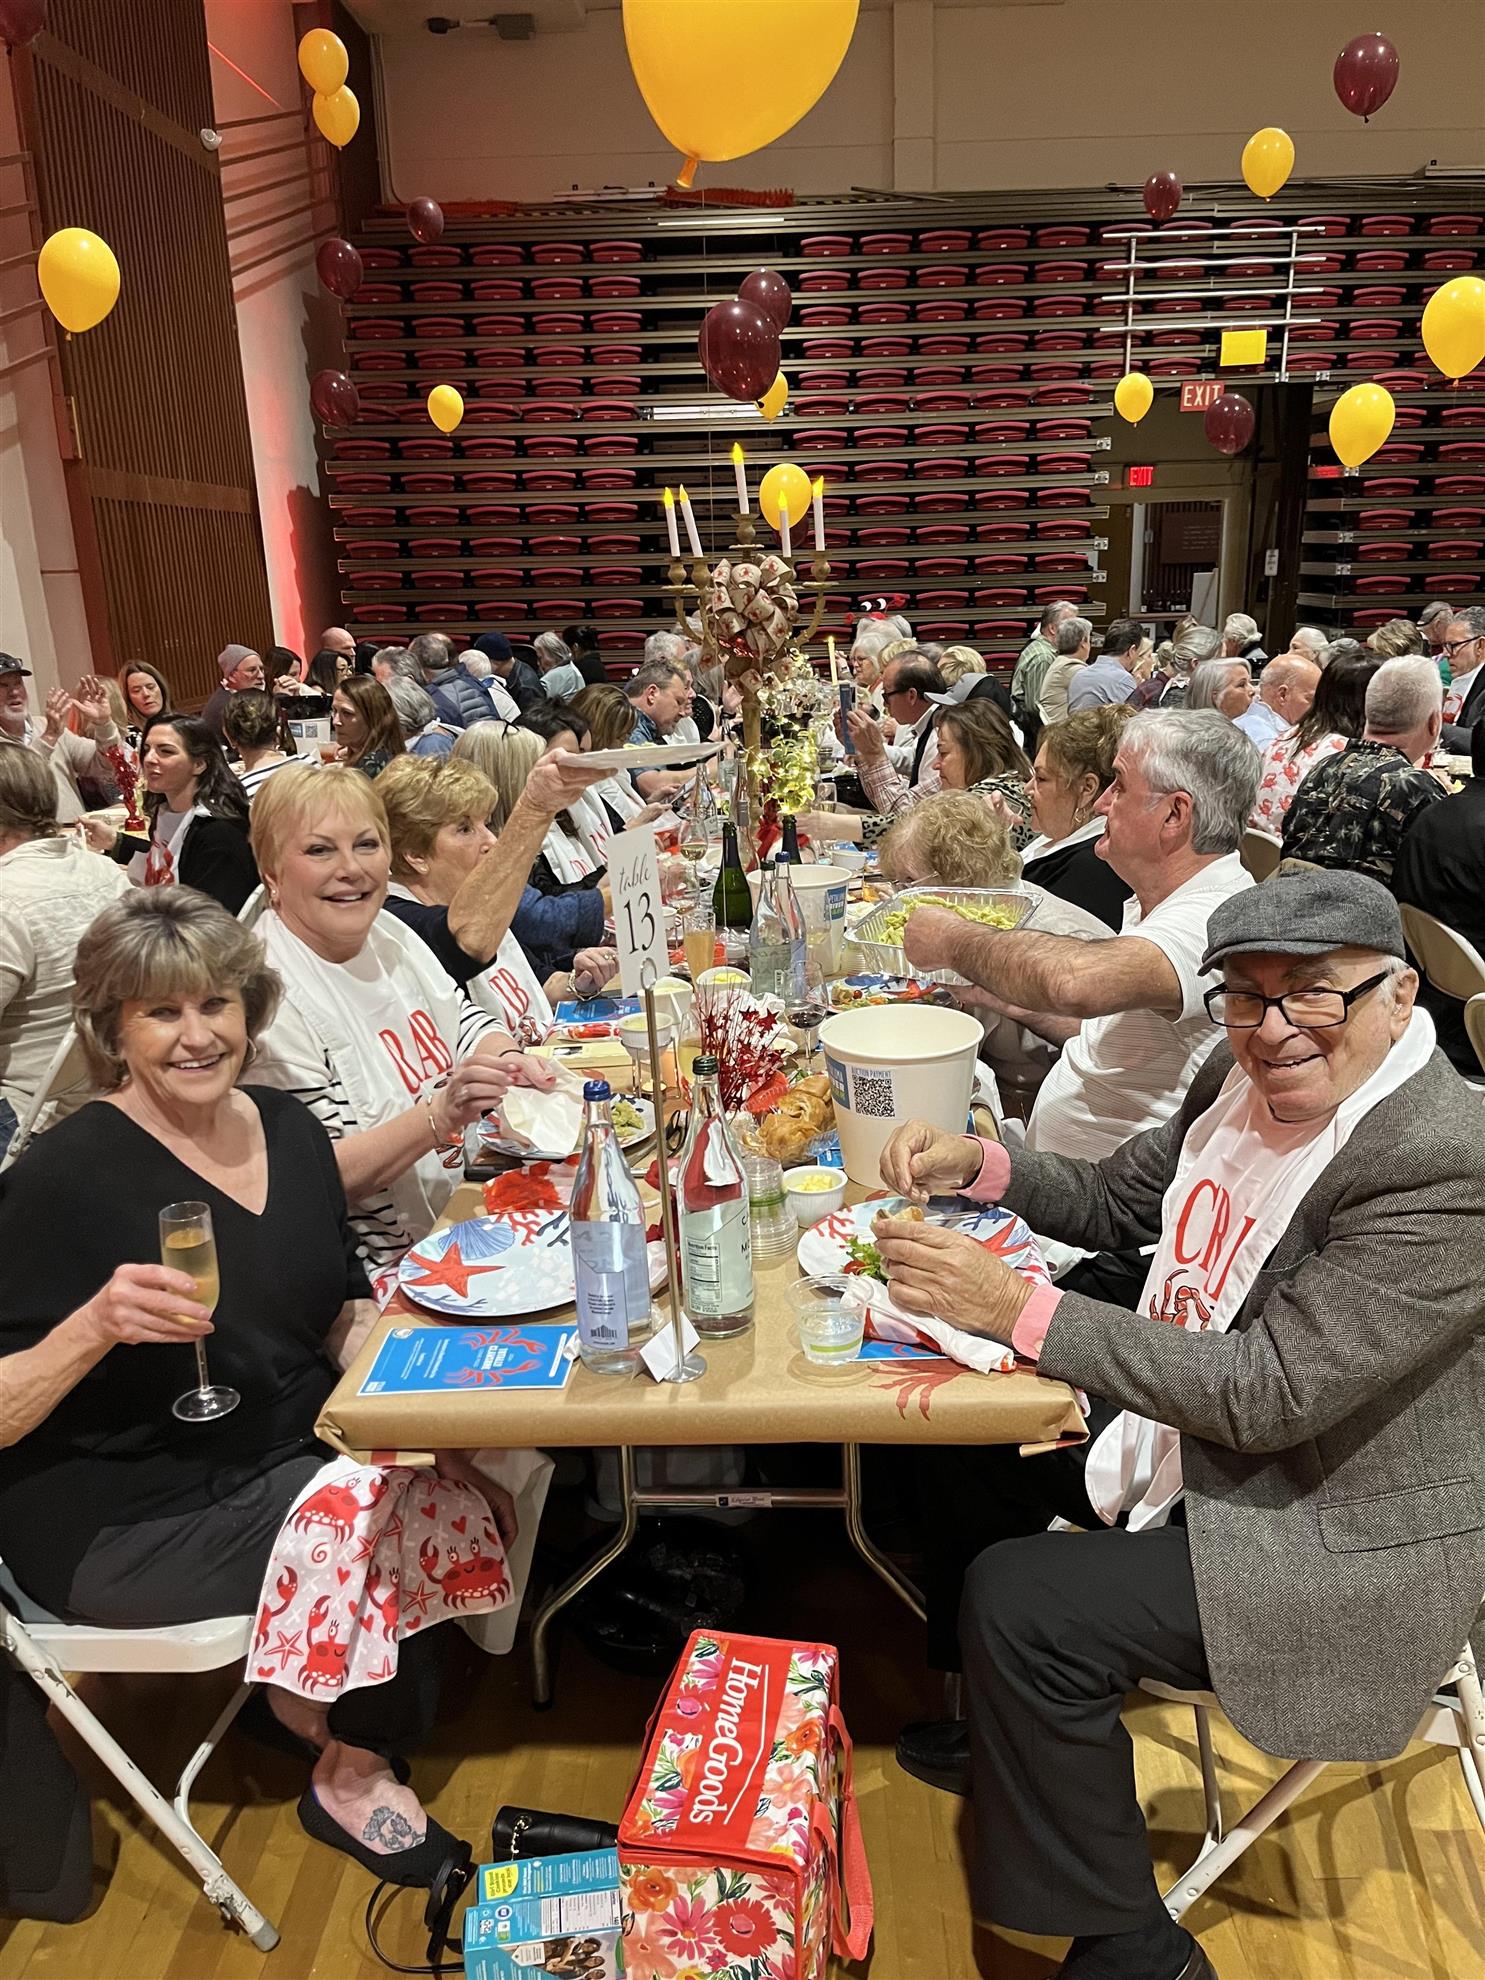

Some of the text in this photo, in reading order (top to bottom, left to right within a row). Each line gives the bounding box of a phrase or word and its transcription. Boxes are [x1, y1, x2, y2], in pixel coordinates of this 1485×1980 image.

[1183, 385, 1221, 407] EXIT
[1129, 466, 1154, 486] EXIT
[619, 853, 651, 895] table
[623, 891, 655, 954] 13
[378, 1009, 454, 1094] RAB
[689, 1656, 763, 1824] HomeGoods
